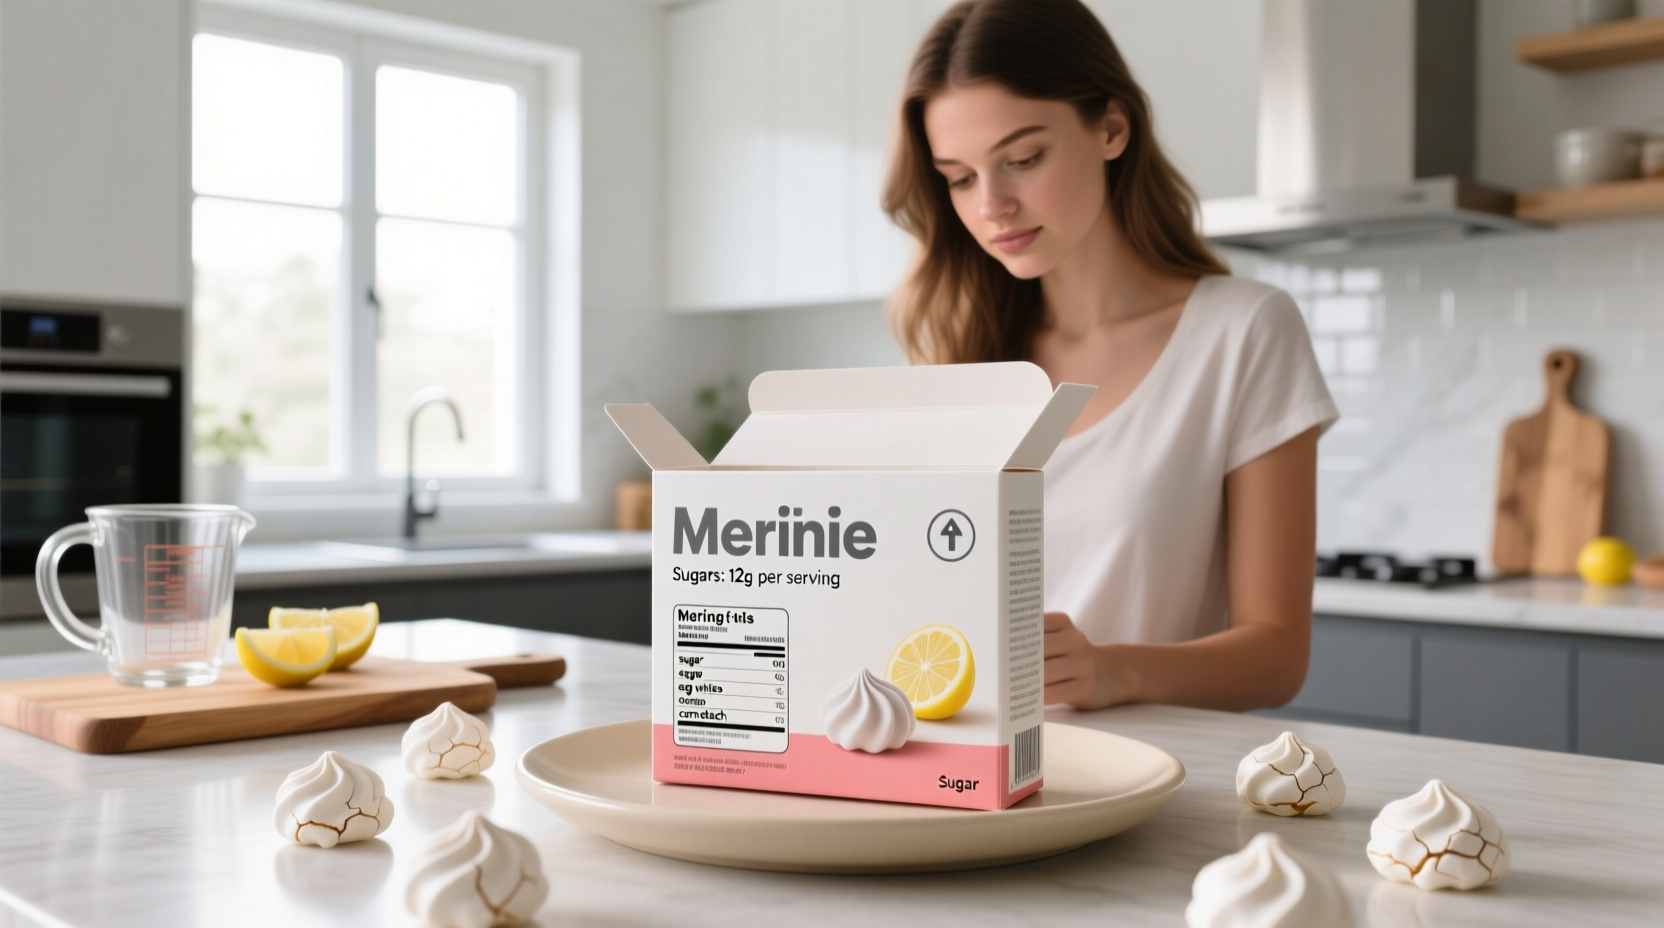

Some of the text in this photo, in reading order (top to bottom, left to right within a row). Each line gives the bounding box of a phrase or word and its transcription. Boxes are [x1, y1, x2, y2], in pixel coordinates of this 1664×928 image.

[673, 566, 841, 589] Sugars: 12g per serving
[678, 609, 724, 626] Mering
[938, 775, 979, 793] Sugar
